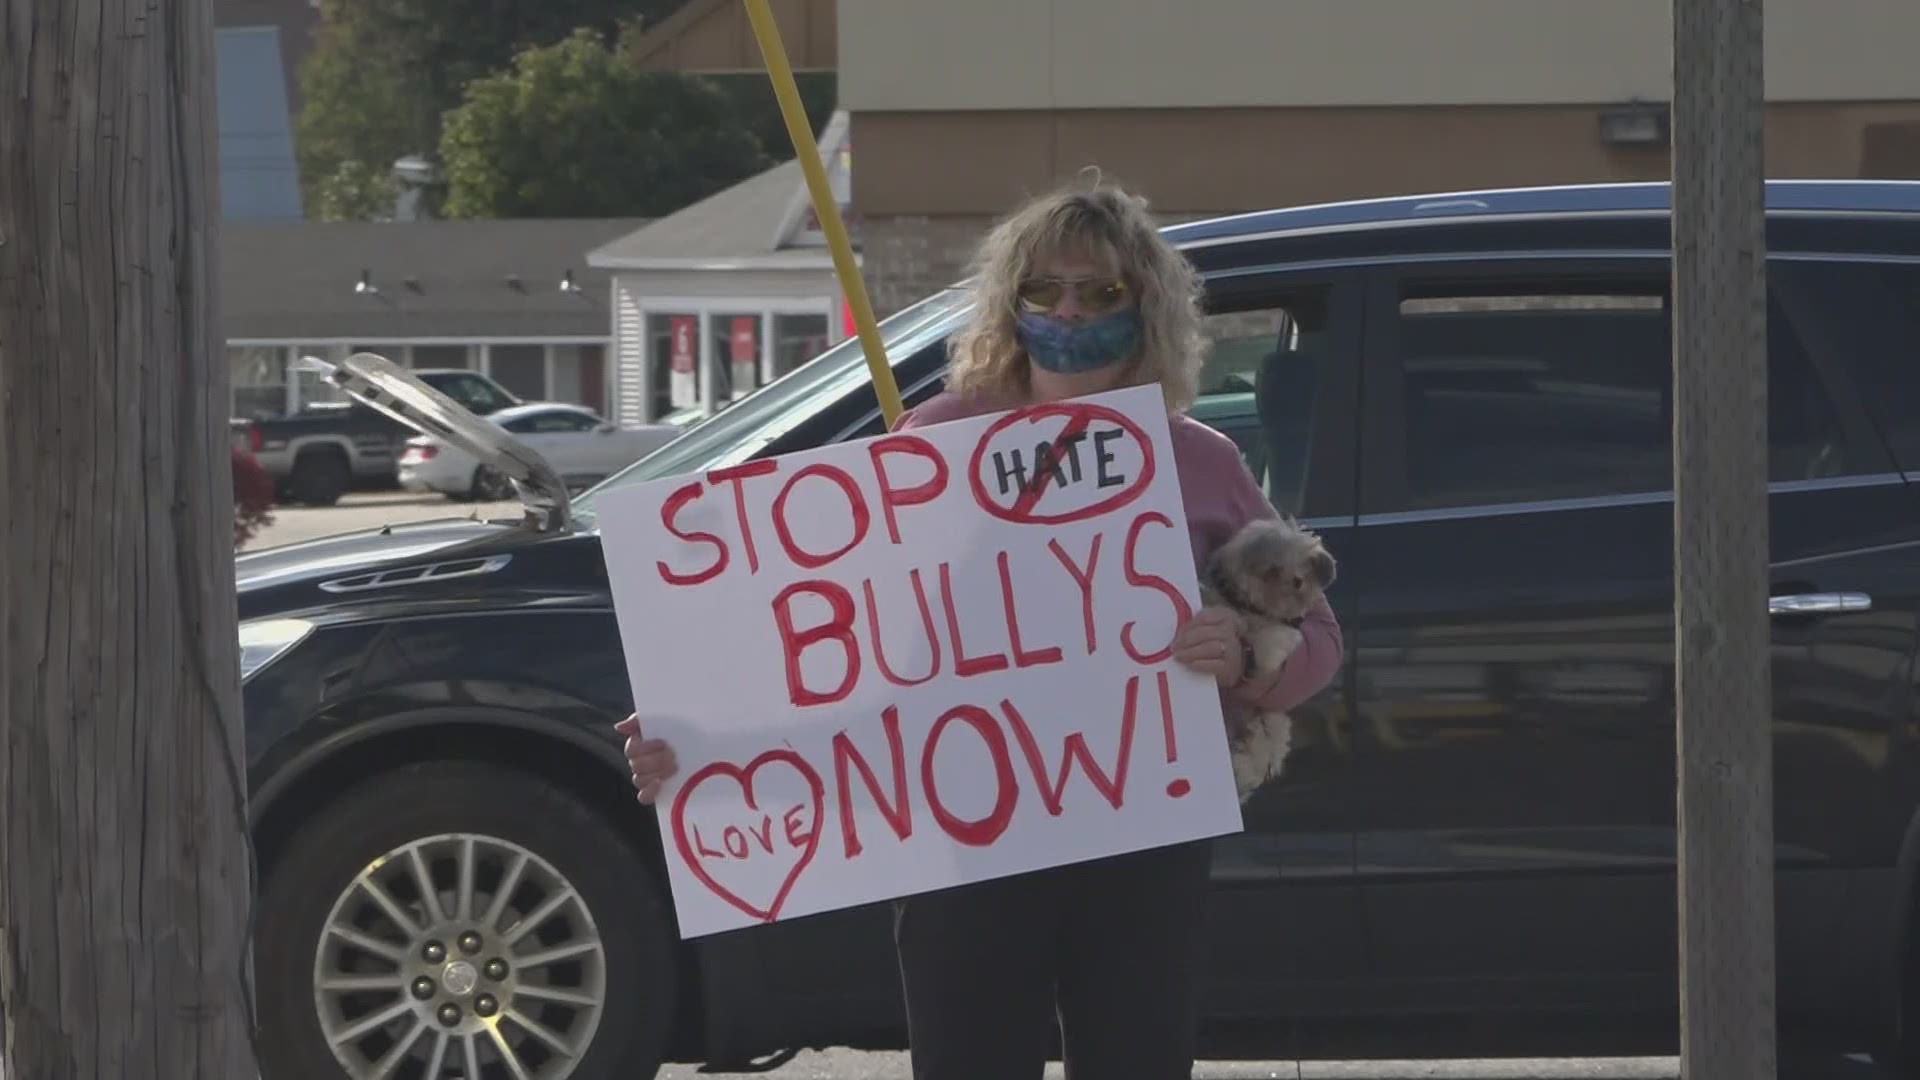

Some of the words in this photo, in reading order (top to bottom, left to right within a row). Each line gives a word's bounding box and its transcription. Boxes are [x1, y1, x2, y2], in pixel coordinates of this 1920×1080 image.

[656, 436, 949, 586] STOP
[991, 428, 1125, 495] HATE
[772, 511, 1194, 706] BULLYS
[692, 804, 809, 859] LOVE
[832, 671, 1191, 859] NOW!
